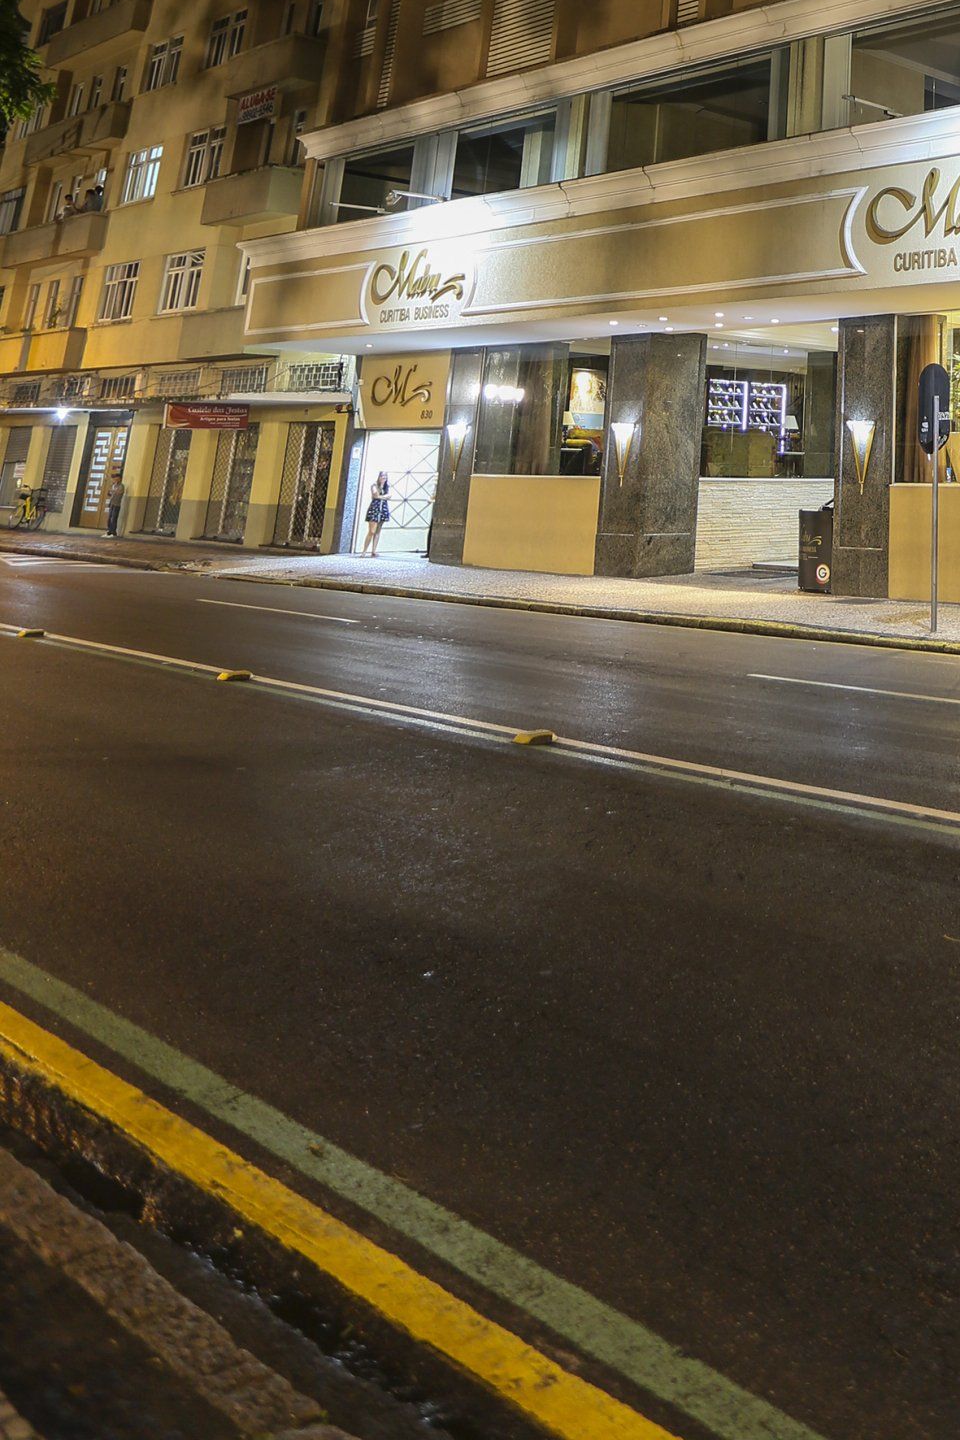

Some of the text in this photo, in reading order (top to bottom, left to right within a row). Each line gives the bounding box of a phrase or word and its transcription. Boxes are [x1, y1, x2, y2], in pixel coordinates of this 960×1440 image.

[893, 247, 957, 272] CURITIBA
[380, 304, 449, 323] CURITIBA BUSINESS
